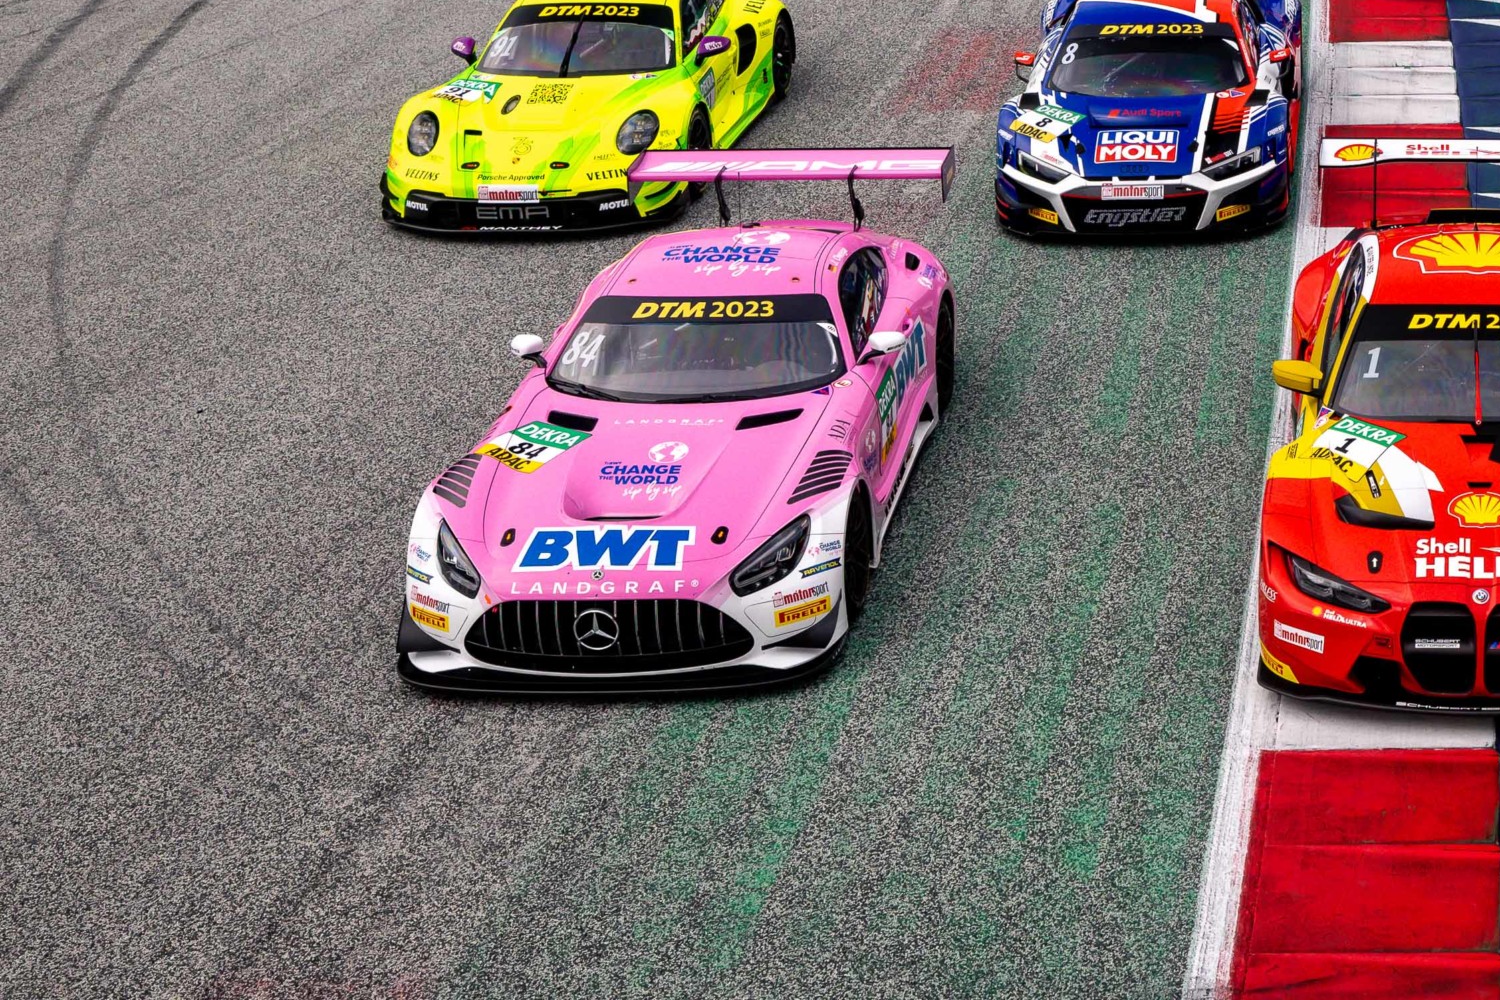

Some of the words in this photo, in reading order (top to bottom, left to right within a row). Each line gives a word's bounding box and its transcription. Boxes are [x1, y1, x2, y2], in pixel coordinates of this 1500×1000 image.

[538, 6, 592, 17] DTM
[594, 5, 640, 17] 2023
[1099, 24, 1153, 35] DTM
[1157, 24, 1204, 35] 2023
[490, 36, 516, 59] 91
[1062, 43, 1079, 64] 8
[1036, 105, 1083, 124] DEKRA
[1035, 118, 1053, 128] 8
[1016, 123, 1046, 141] ADAC
[1101, 130, 1176, 144] LIQUI
[1097, 145, 1176, 161] MOLY
[406, 168, 439, 181] VELTINS
[741, 161, 943, 172] AMG
[477, 173, 510, 181] Porsche
[512, 173, 545, 182] Approved
[1113, 185, 1164, 199] motorsport
[406, 200, 428, 212] MOTUL
[476, 206, 549, 219] EMA
[664, 246, 781, 256] CHANGE
[683, 253, 777, 264] WORLD
[632, 302, 705, 319] DTM
[710, 301, 775, 318] 2023
[1408, 313, 1480, 330] DTM
[562, 331, 606, 368] 84
[1362, 347, 1383, 379] 1
[518, 423, 580, 447] DEKRA
[1333, 419, 1397, 444] DEKRA
[509, 443, 548, 459] 84
[1335, 438, 1357, 454] 1
[485, 447, 531, 470] ADAC
[1310, 447, 1353, 473] ADAC
[600, 465, 682, 475] CHANGE
[614, 475, 679, 485] WORLD
[519, 530, 690, 567] BWT
[1416, 538, 1471, 555] Shell
[779, 599, 827, 623] PIRELLI
